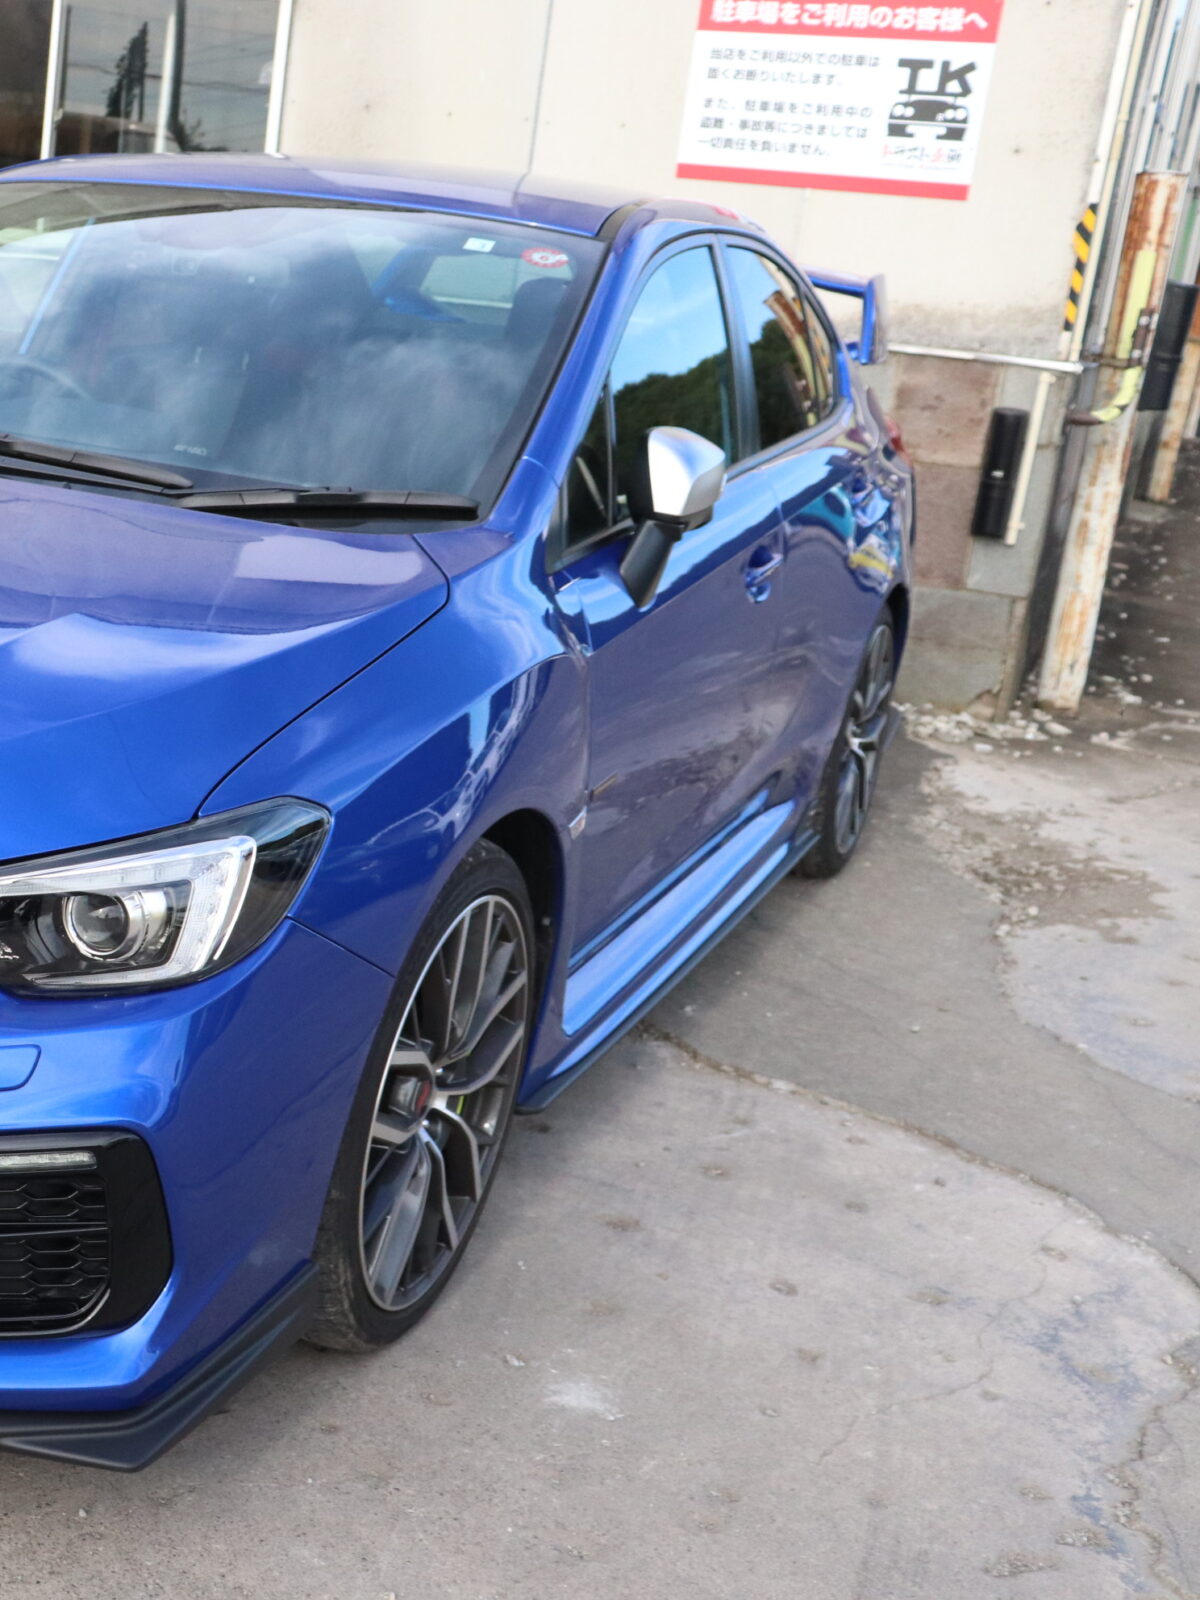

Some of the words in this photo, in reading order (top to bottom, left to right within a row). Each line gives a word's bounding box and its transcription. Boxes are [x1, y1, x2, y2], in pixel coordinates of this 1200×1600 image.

[710, 0, 988, 31] 駐車場をご利用のお客様へ
[898, 58, 978, 98] TK
